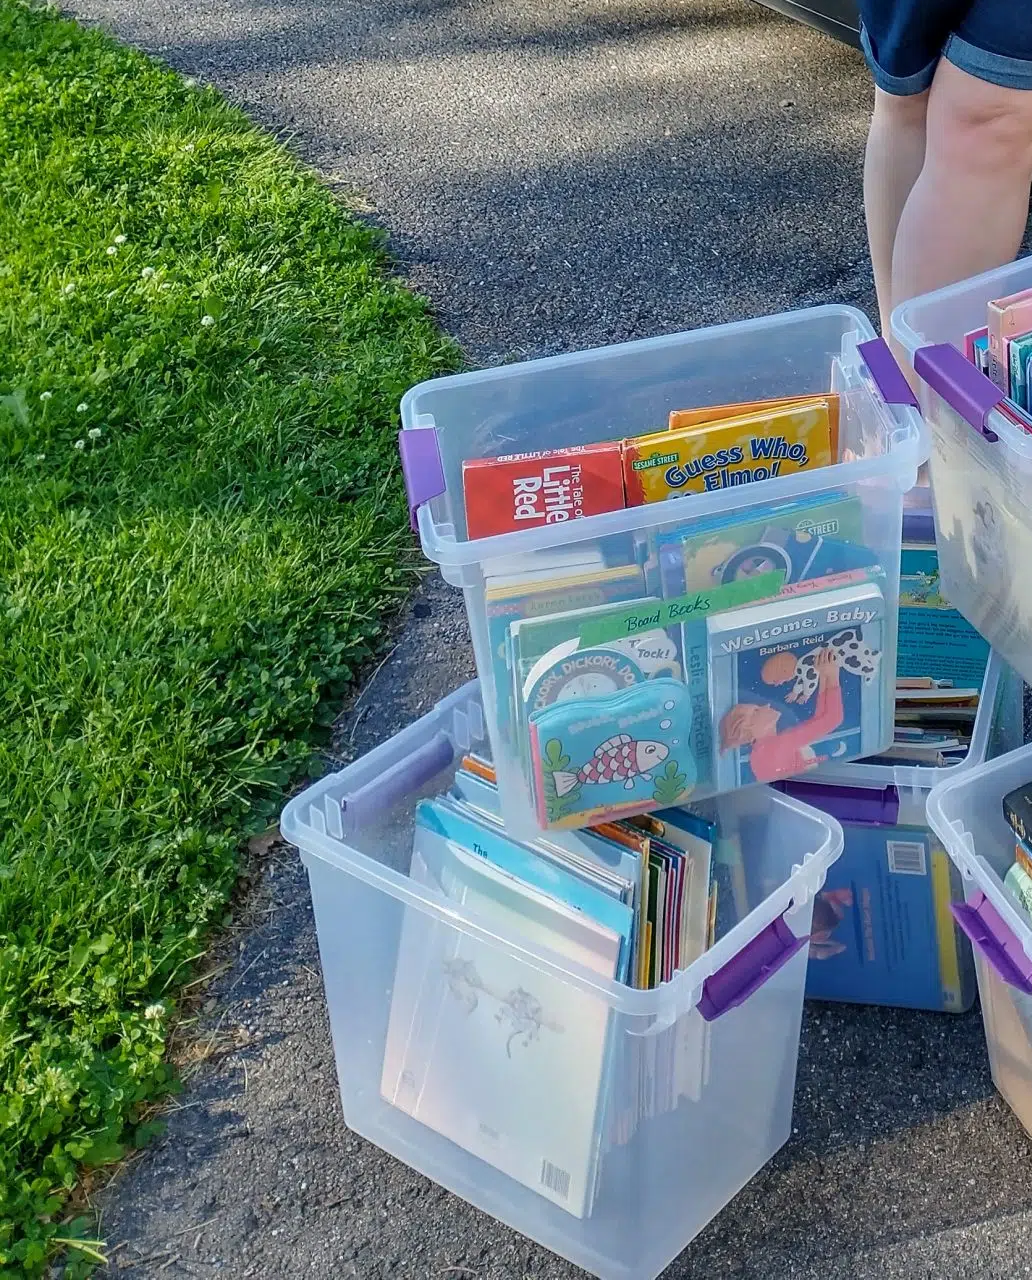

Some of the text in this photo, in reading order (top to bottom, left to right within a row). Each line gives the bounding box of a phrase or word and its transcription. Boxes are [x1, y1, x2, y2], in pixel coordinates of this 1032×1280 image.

[634, 454, 678, 470] SESAME STREET
[664, 436, 809, 488] Guess Who,
[571, 464, 582, 484] The
[703, 461, 781, 493] Elmo!
[513, 476, 544, 520] Red
[543, 465, 573, 523] Little
[573, 486, 584, 506] Tale
[624, 595, 711, 632] Board Books
[720, 607, 877, 654] Welcome, Baby
[638, 648, 670, 659] Tock!
[759, 634, 824, 657] Barbara Reid
[561, 655, 621, 676] DICKORY,
[473, 842, 488, 859] The
